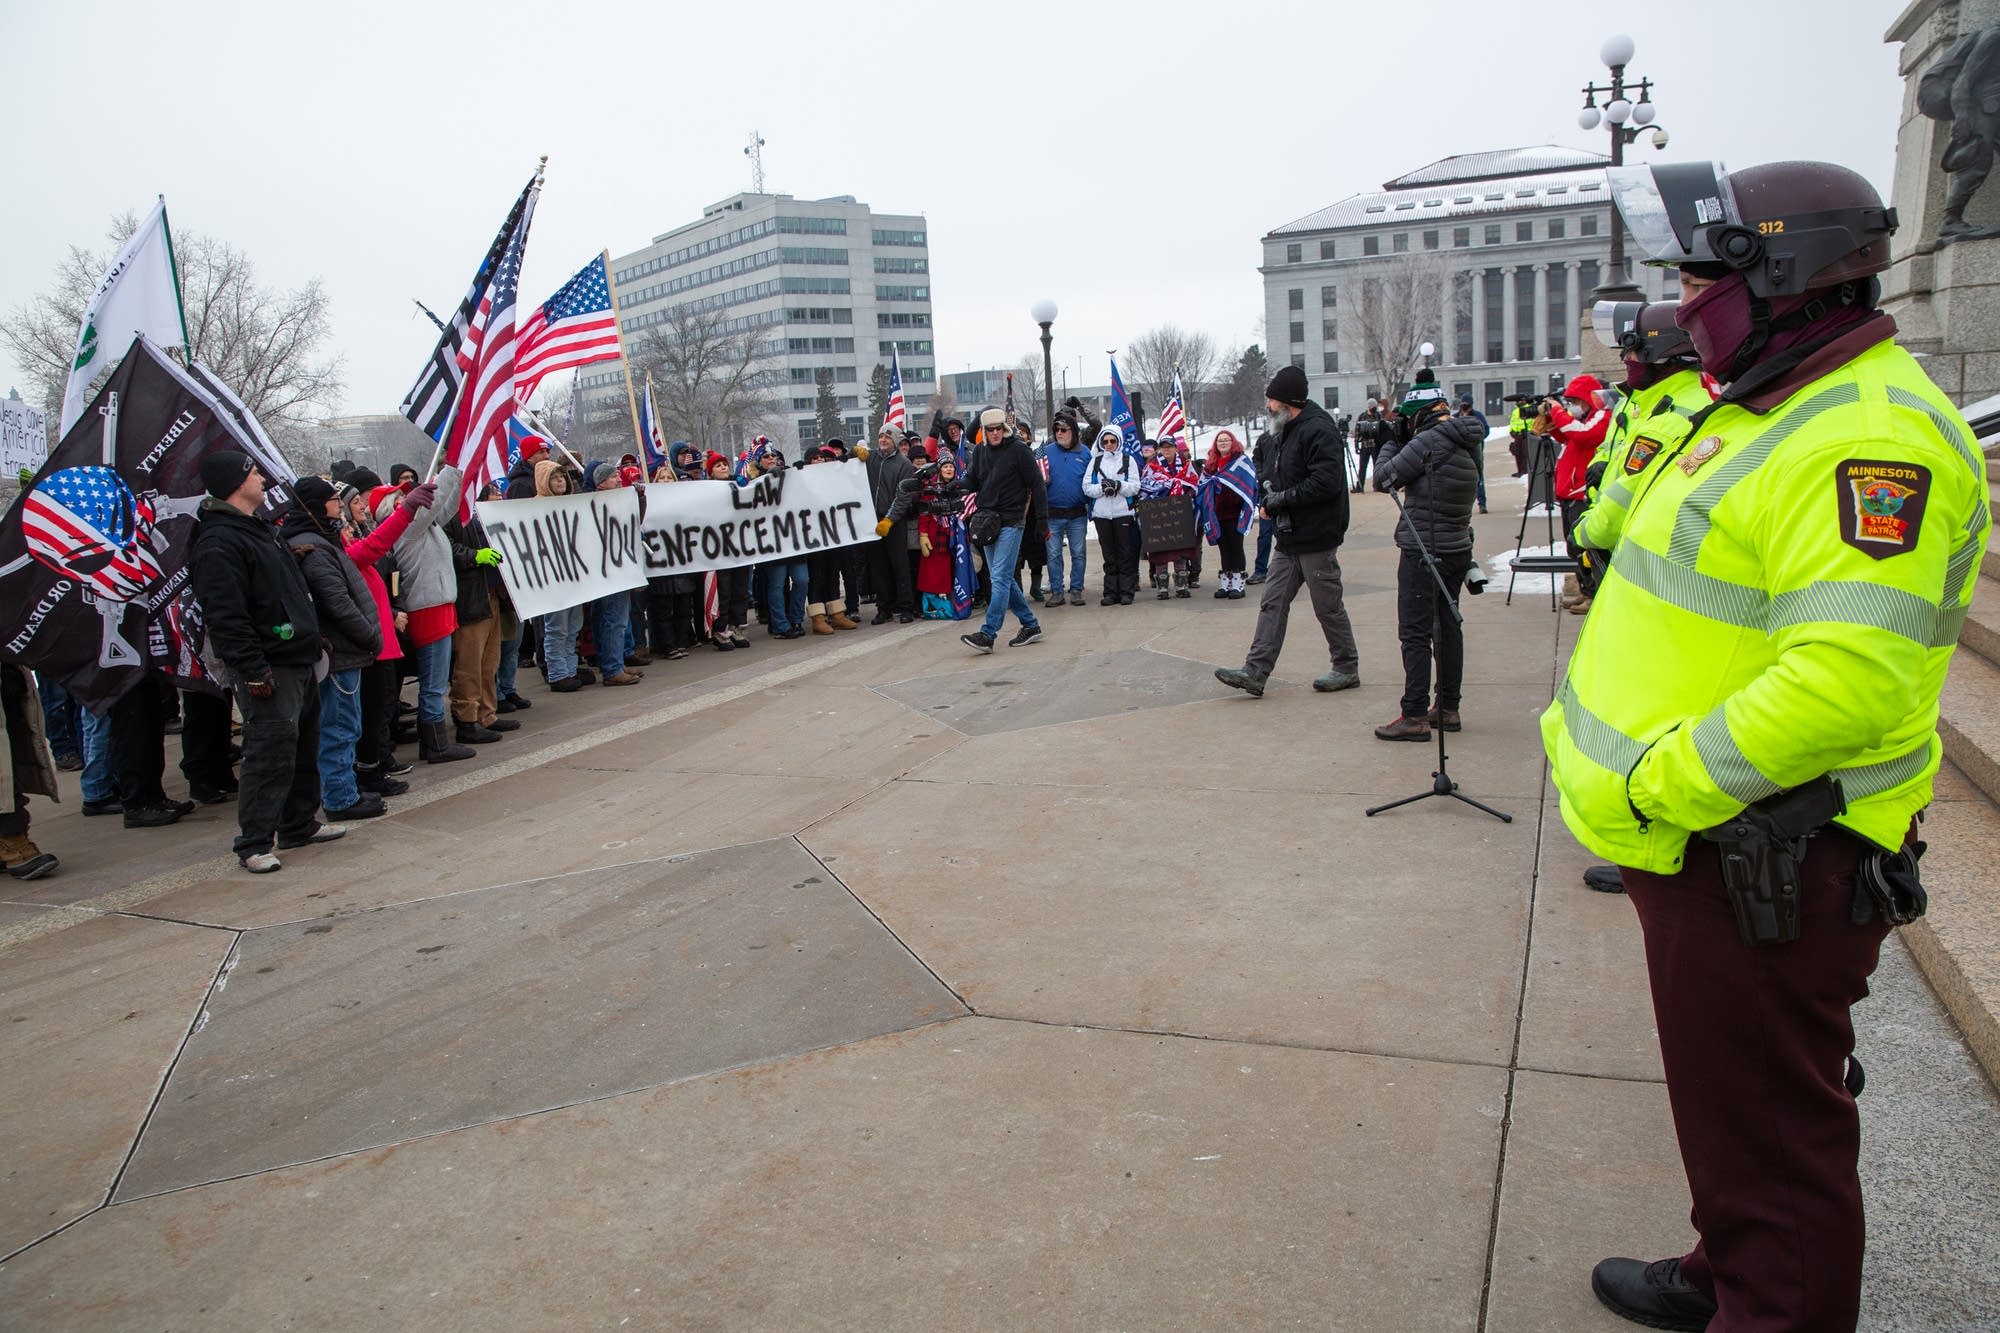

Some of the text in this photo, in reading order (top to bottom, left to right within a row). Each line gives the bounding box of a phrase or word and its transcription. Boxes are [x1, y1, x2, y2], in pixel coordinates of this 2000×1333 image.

[1757, 220, 1785, 234] 312
[2, 424, 46, 456] America
[1847, 466, 1918, 480] MINNESOTA
[729, 471, 785, 510] LAW
[1867, 526, 1900, 538] PATROL
[1870, 515, 1900, 527] STATE
[486, 499, 638, 590] THANK YOU
[644, 501, 862, 568] ENFORCEMENT
